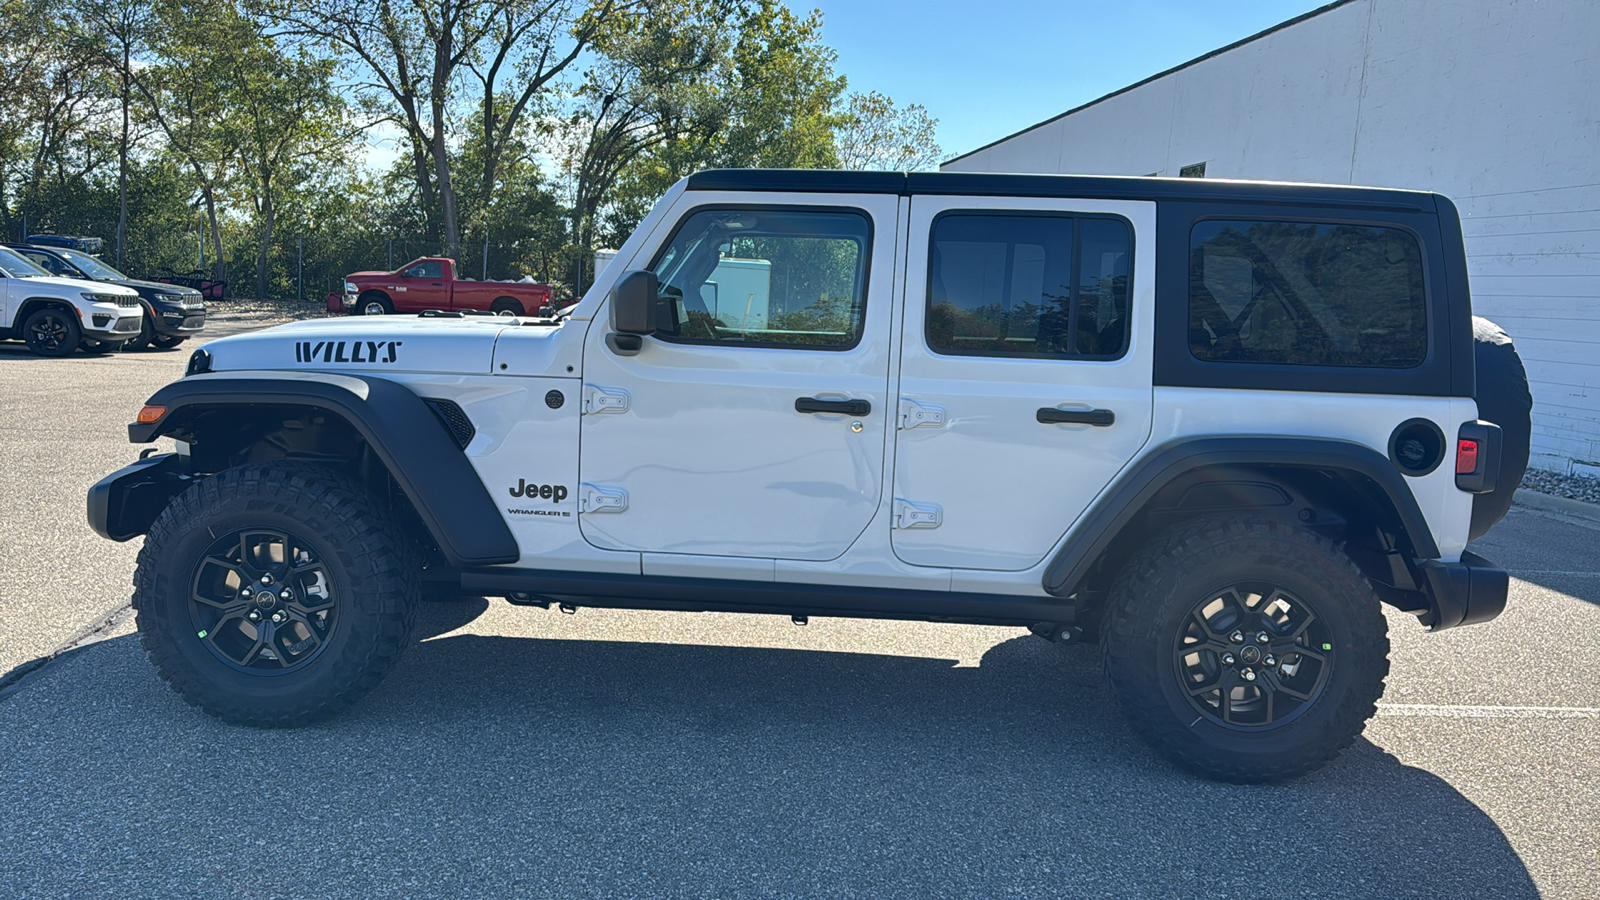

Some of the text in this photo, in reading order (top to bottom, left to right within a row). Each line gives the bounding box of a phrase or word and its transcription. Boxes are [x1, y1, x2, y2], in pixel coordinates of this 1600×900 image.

[295, 341, 403, 363] WILLYS
[509, 478, 568, 503] Jeep
[507, 508, 561, 517] WRANGLER
